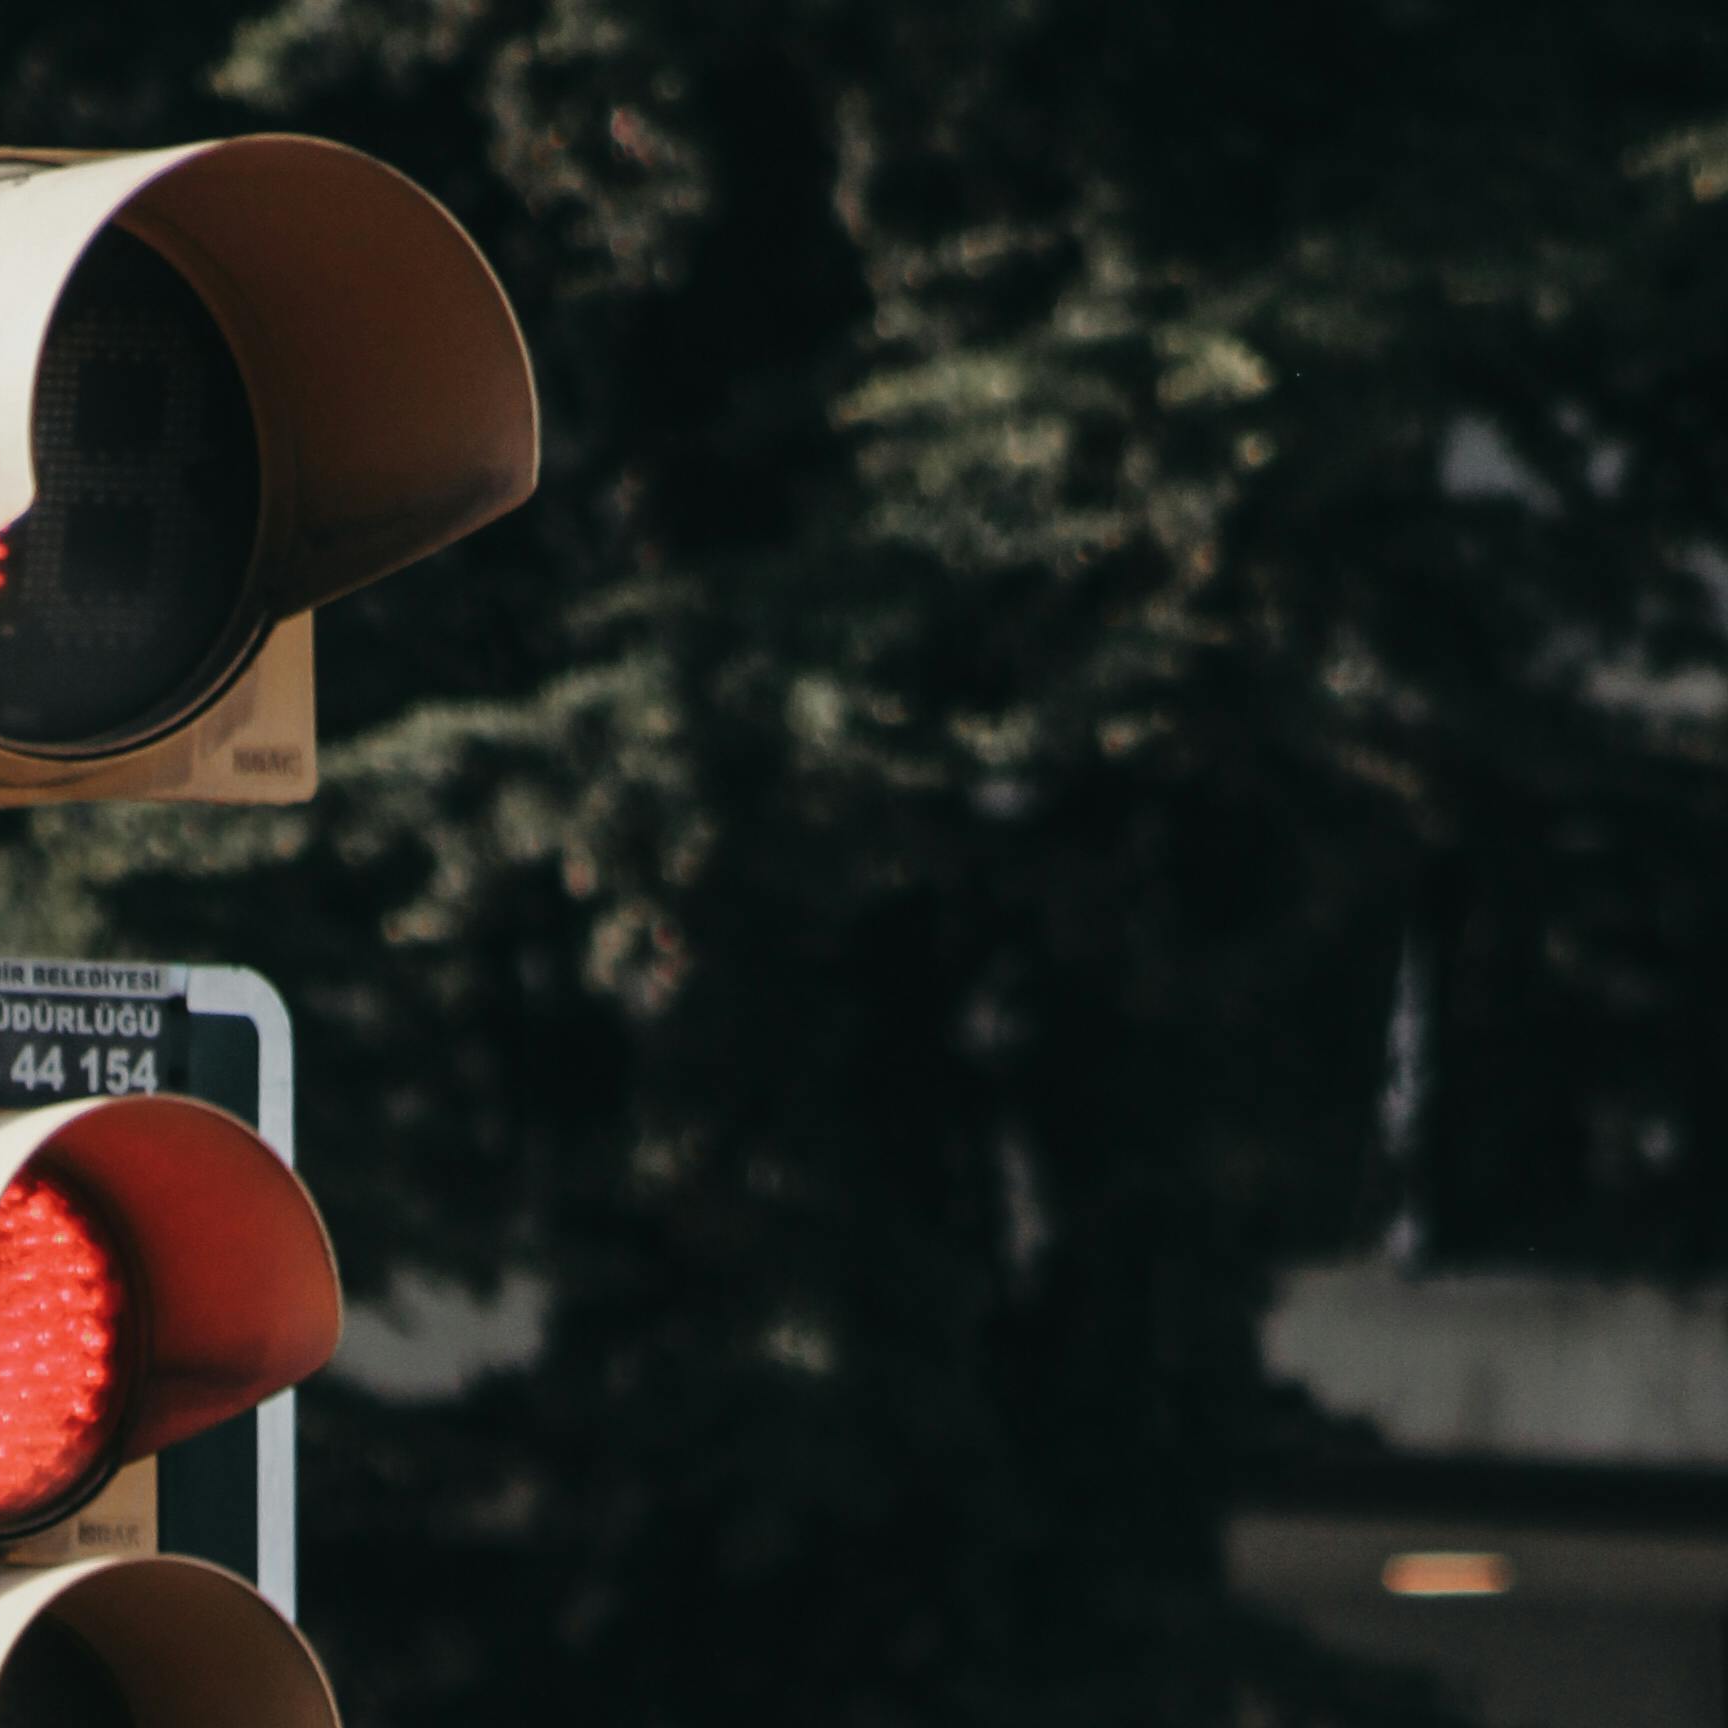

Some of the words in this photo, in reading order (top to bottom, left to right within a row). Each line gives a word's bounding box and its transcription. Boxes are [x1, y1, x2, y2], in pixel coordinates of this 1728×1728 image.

[32, 964, 160, 992] BELEDİYESİ
[10, 1044, 65, 1091] 44
[79, 1046, 158, 1096] 154
